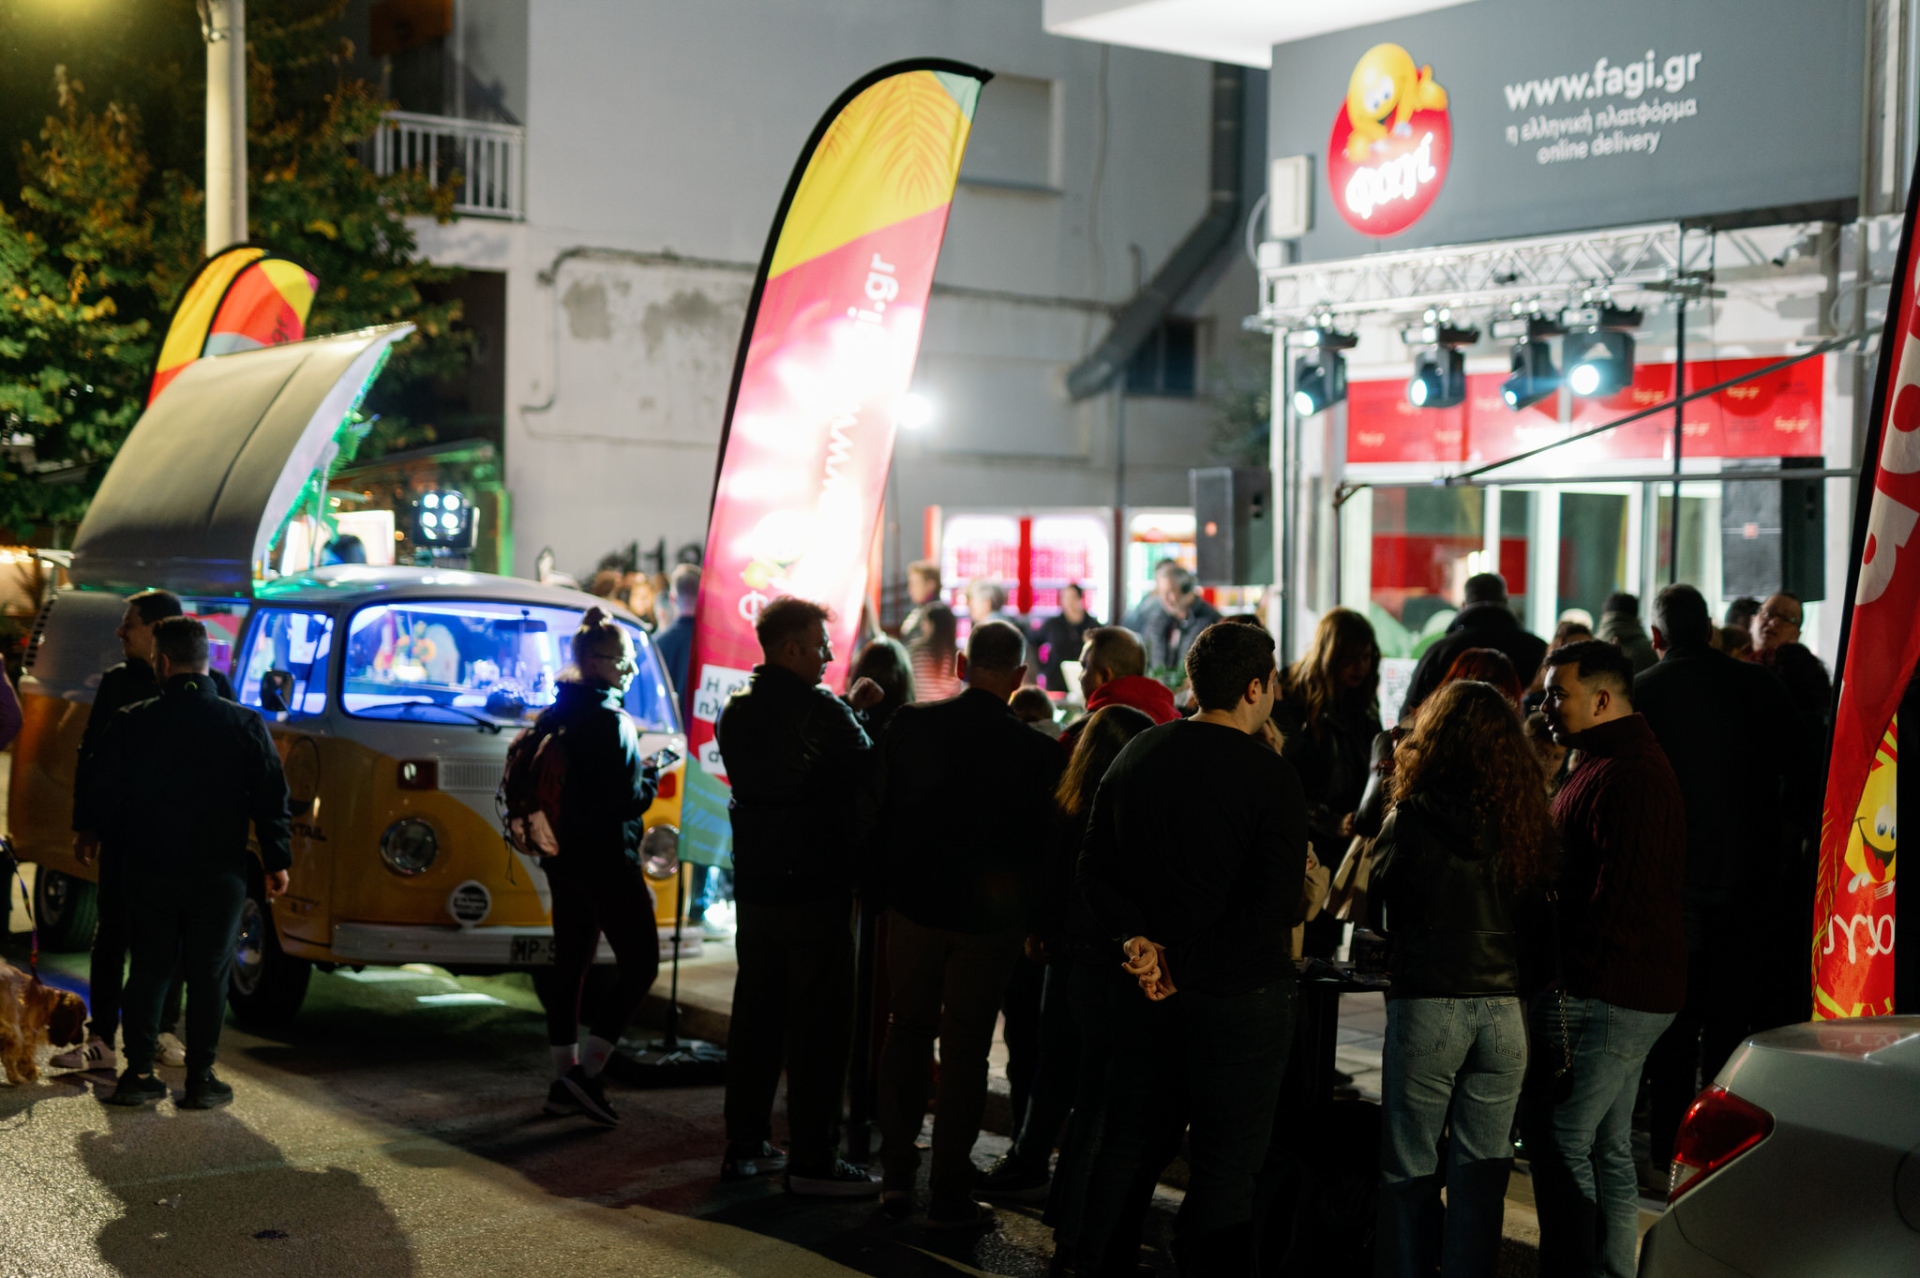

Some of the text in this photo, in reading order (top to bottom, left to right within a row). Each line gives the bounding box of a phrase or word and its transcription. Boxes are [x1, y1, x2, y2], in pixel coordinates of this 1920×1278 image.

[1504, 49, 1702, 111] www.fagi.gr
[1505, 98, 1698, 146] η ελληνική πλατφόρμα
[1537, 130, 1661, 165] online delivery
